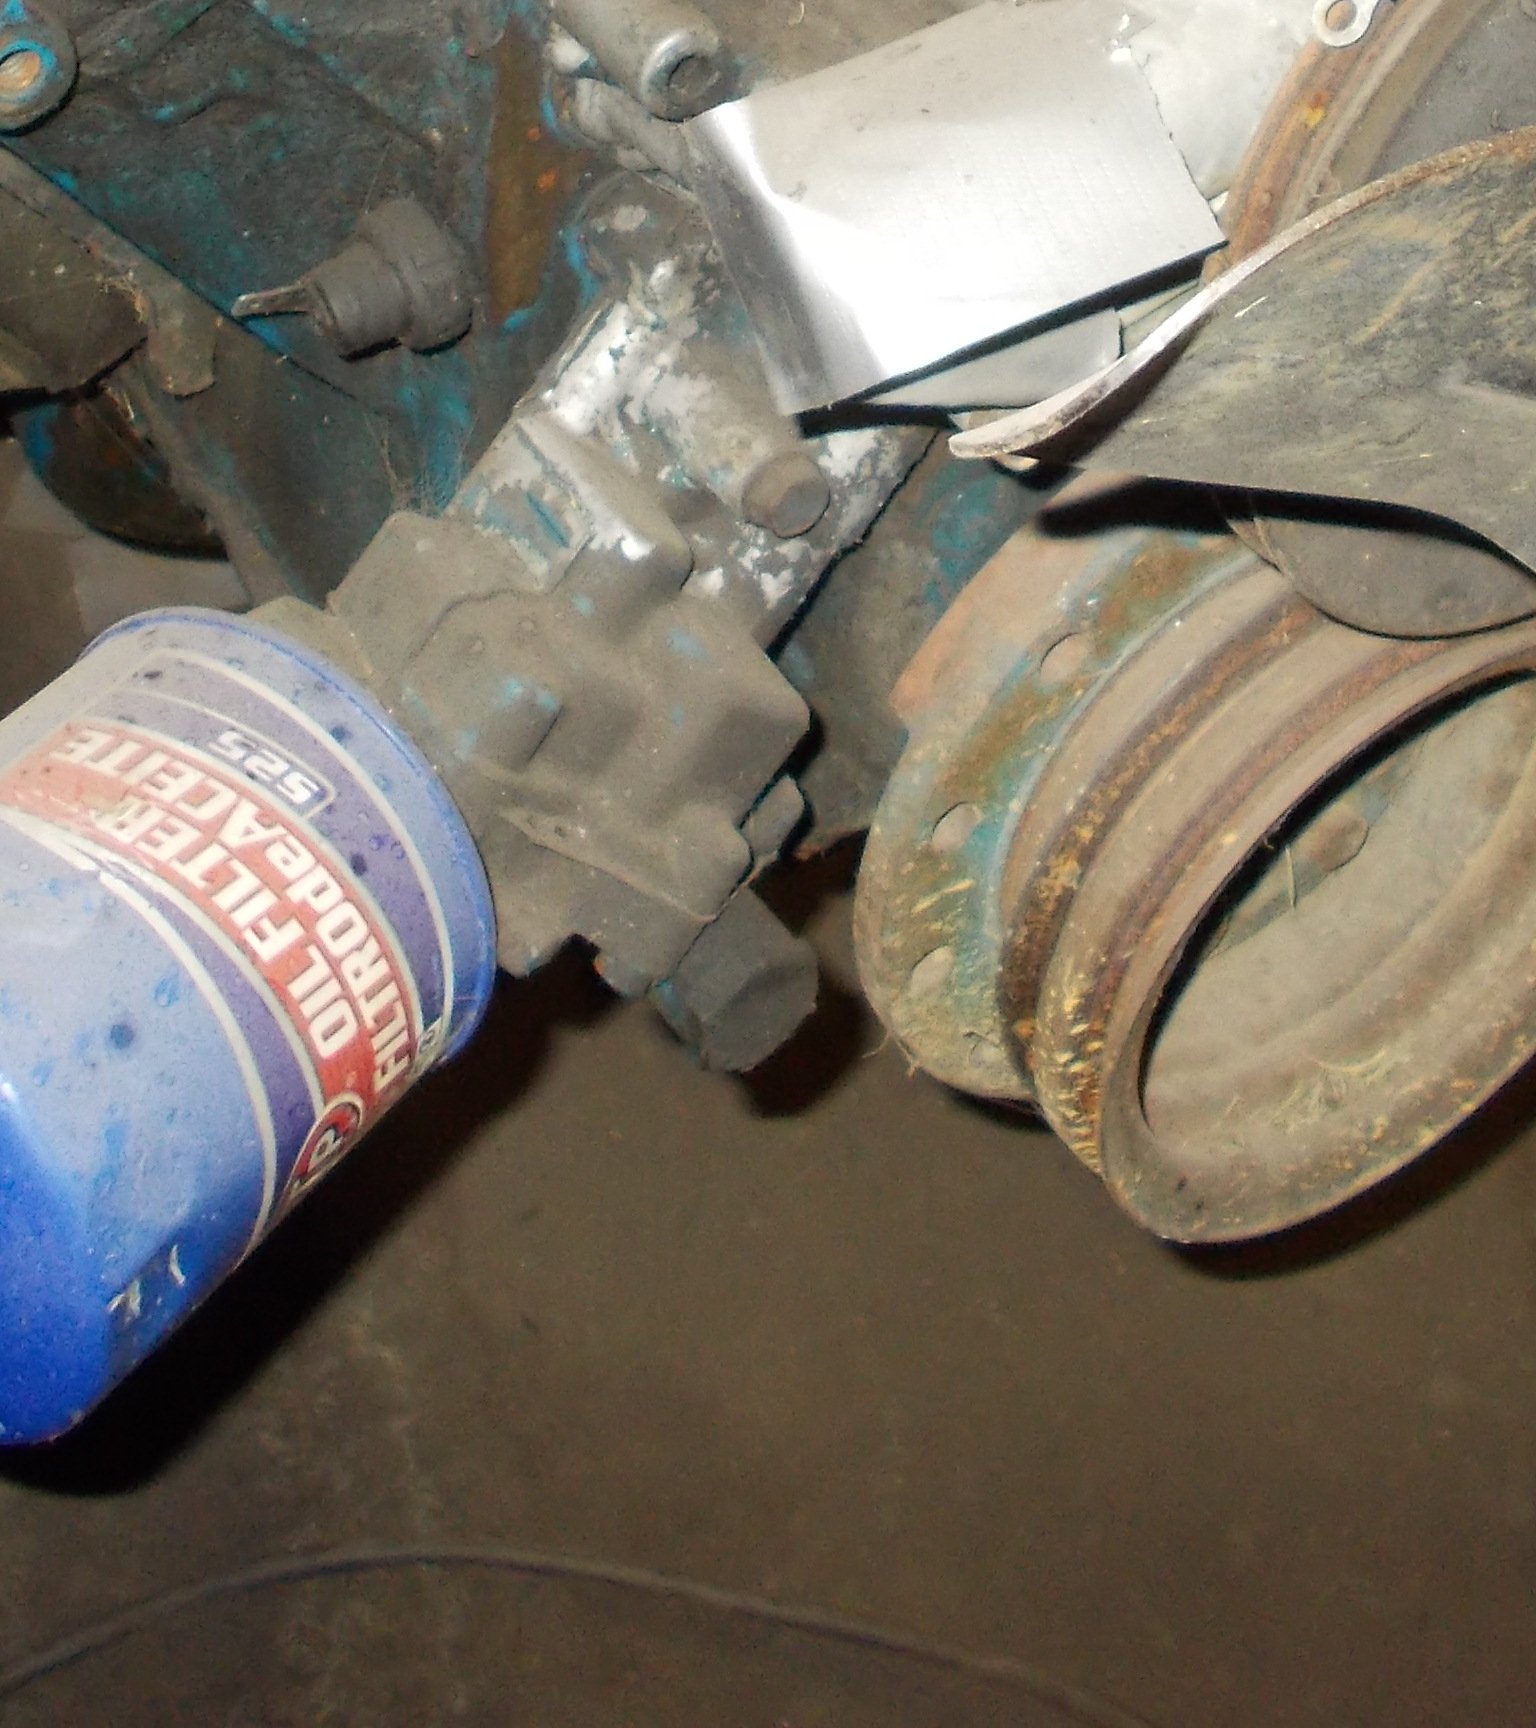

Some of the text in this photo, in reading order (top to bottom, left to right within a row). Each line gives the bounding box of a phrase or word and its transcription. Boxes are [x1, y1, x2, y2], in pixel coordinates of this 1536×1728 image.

[48, 728, 290, 849] ACEITE
[88, 794, 360, 1059] OIL FILTER
[316, 900, 413, 1094] FILTRO
